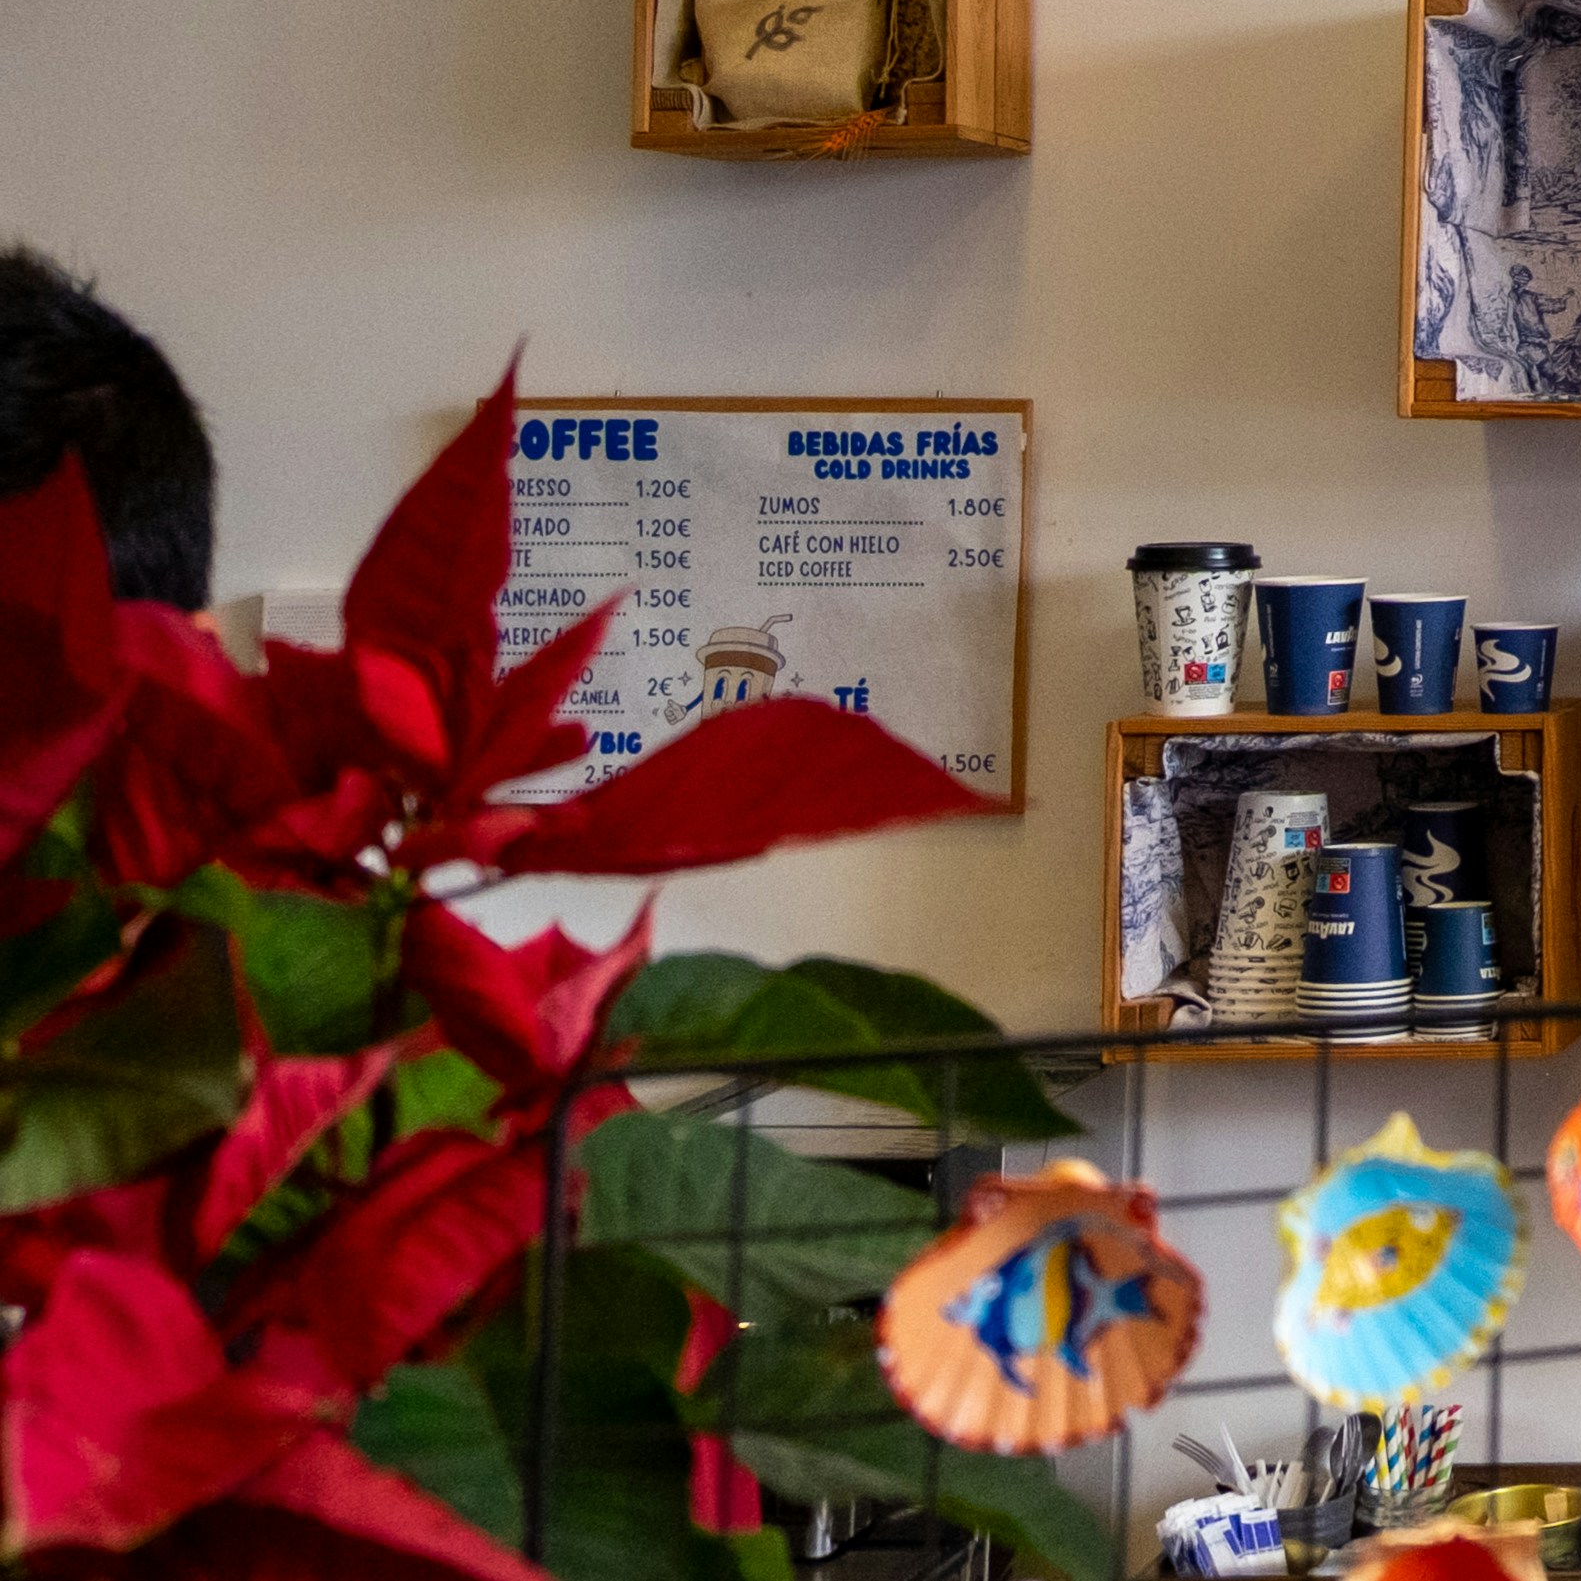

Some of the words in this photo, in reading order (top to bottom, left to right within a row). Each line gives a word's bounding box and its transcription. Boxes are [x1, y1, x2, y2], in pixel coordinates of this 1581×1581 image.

[788, 431, 904, 457] BEBIDAS
[916, 422, 999, 457] FRÍAS
[814, 458, 872, 480] COLD
[881, 458, 971, 480] DRINKS
[635, 479, 691, 498] 1.20€
[759, 496, 821, 515] ZUMOS
[948, 498, 1006, 517] 1.80€
[635, 518, 691, 538] 1.20€
[635, 550, 691, 569] 1.50€
[759, 530, 800, 555] CAFÉ
[807, 535, 844, 554] CON
[850, 535, 900, 554] HIELO
[948, 548, 1005, 569] 2.50€
[759, 561, 794, 578] ICED
[800, 561, 852, 578] COFFEE
[633, 588, 692, 608] 1.50€
[632, 628, 691, 648] 1.50€
[647, 677, 673, 697] 2€
[833, 677, 870, 714] TÉ
[940, 754, 997, 773] 1.50€
